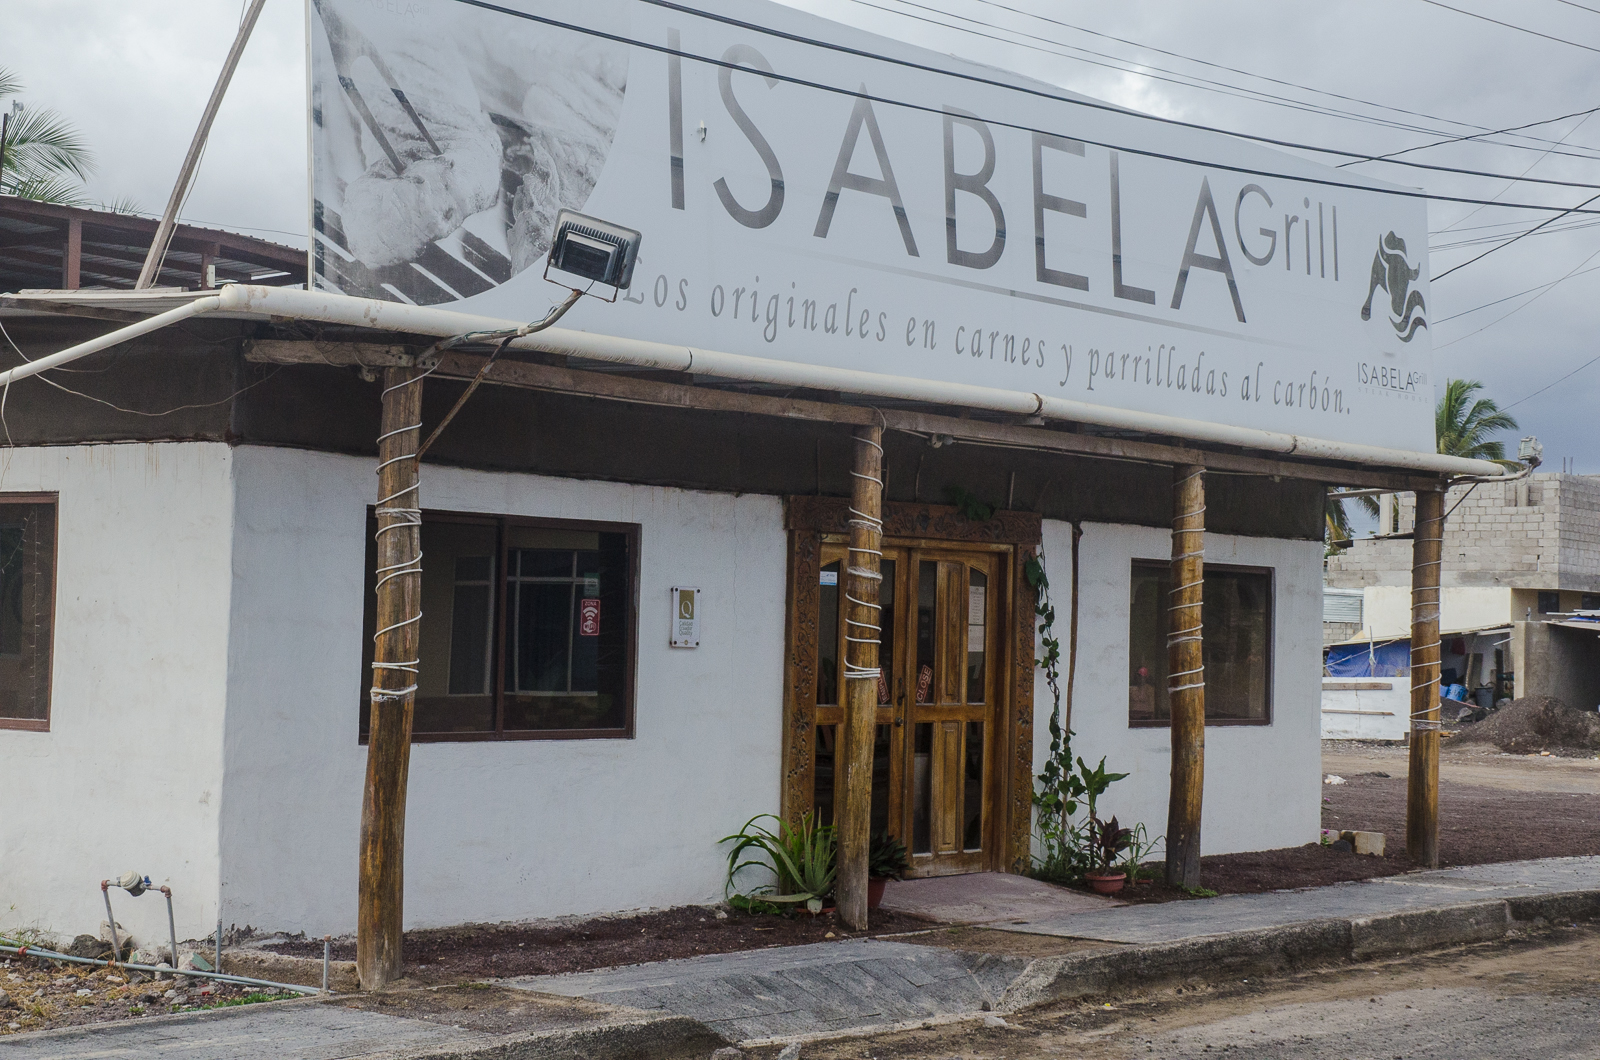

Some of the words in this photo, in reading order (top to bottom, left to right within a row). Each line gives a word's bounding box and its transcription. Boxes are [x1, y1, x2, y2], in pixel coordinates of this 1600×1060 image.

[666, 27, 1247, 324] ISABELA
[1234, 183, 1340, 282] Grill
[710, 275, 888, 343] originales
[906, 316, 937, 350] en
[954, 325, 1046, 368] carnes
[1059, 343, 1073, 387] y
[1086, 343, 1228, 398] parrilladas
[1241, 361, 1264, 402] al
[1273, 370, 1350, 415] carbón.
[1357, 362, 1416, 392] ISABELA
[1358, 387, 1390, 397] STEAK
[1397, 393, 1428, 404] HOUSE
[681, 600, 692, 618] Q
[916, 667, 931, 701] CLOSE
